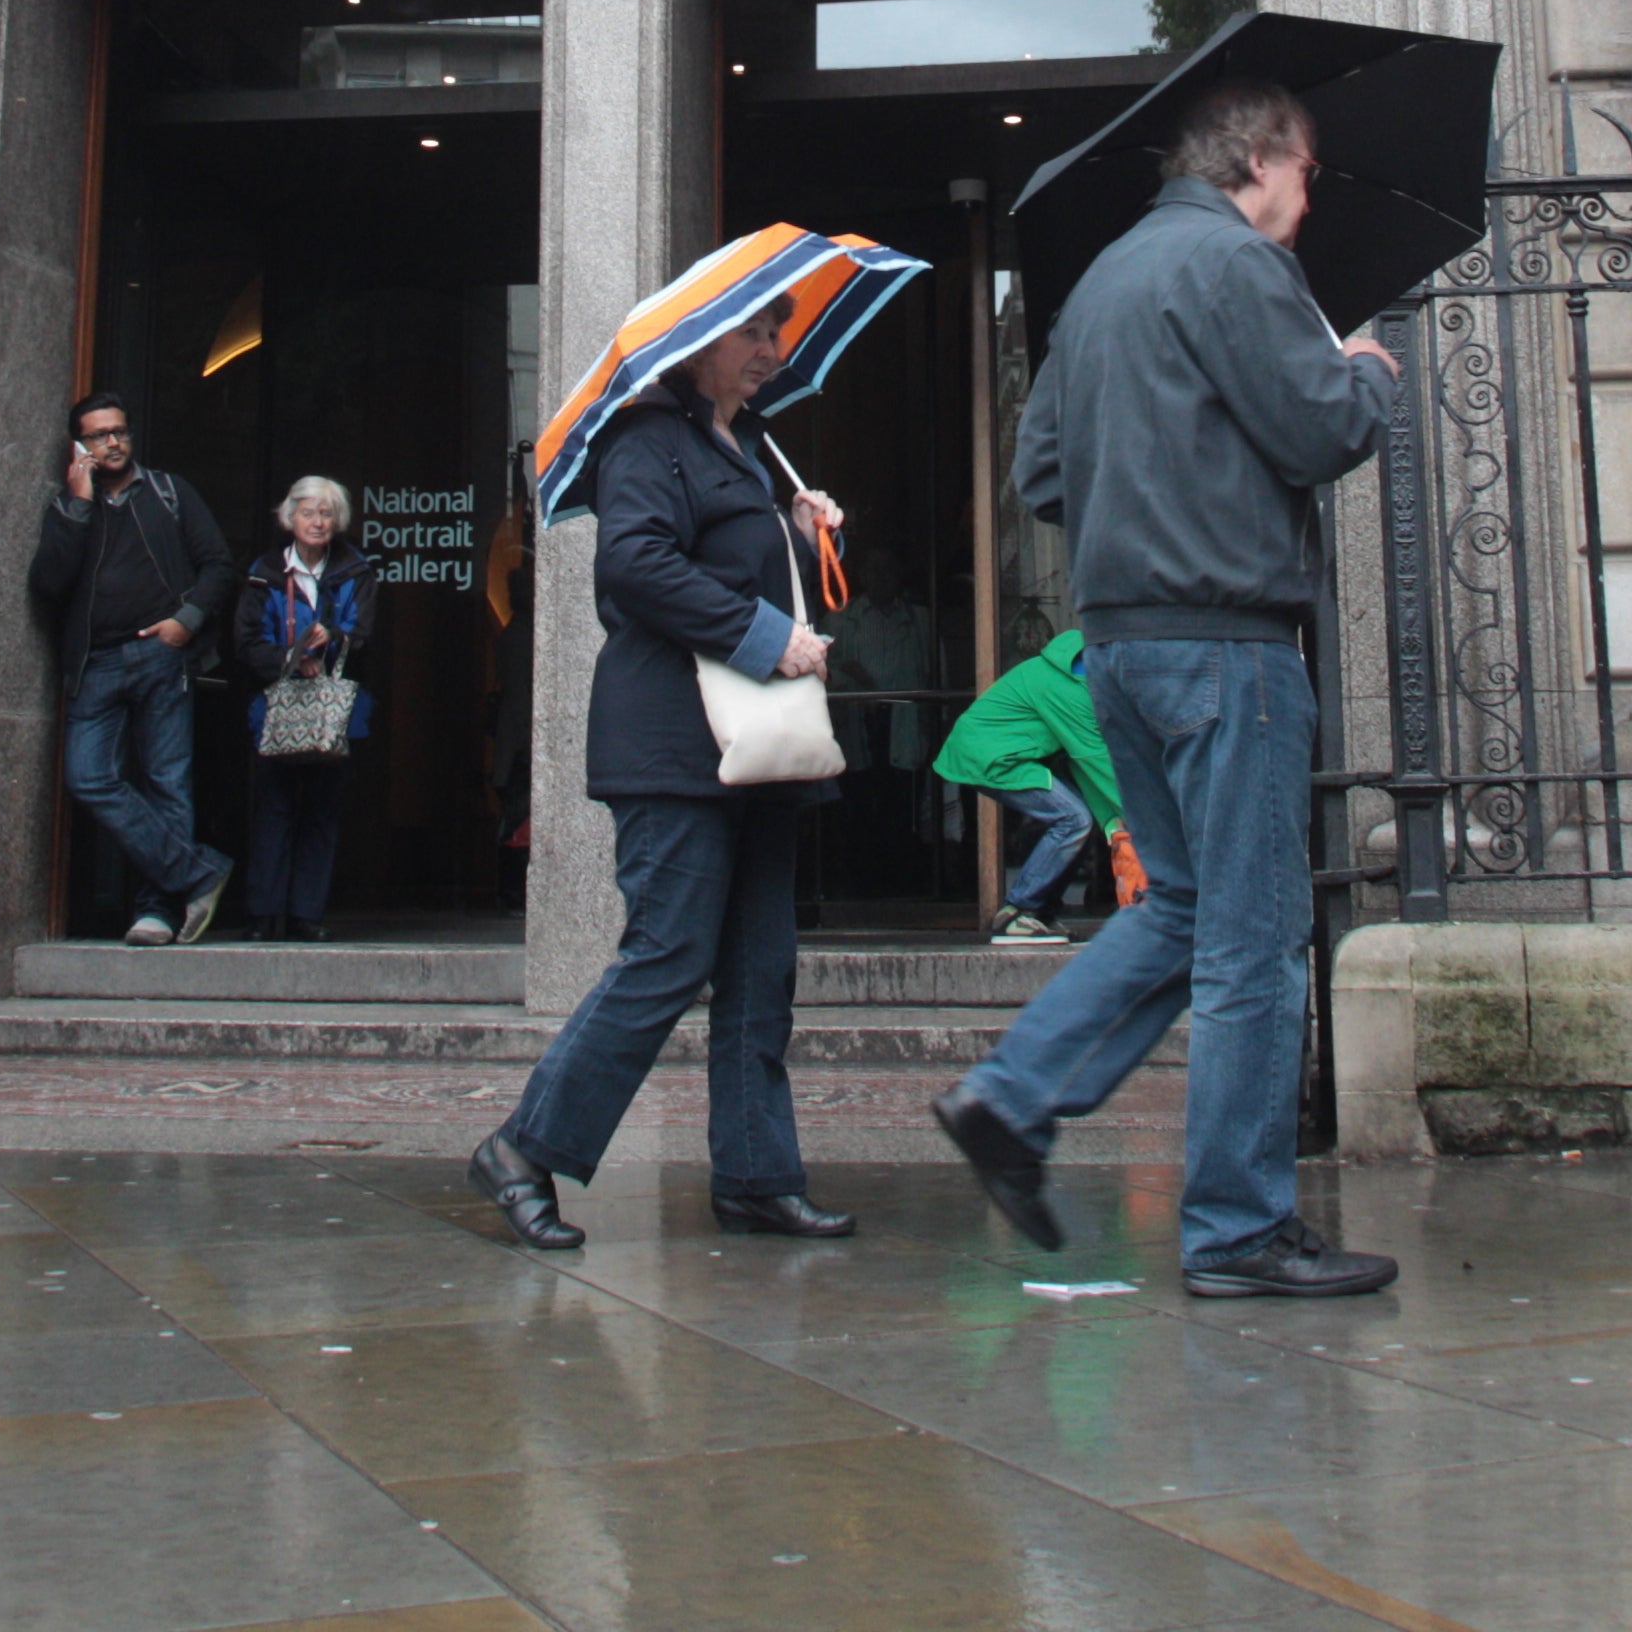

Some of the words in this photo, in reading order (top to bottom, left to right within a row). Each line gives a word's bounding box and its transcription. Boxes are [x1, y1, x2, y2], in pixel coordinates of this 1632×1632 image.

[363, 484, 474, 514] National
[362, 520, 474, 549] Portrait
[365, 554, 473, 591] Gallery
